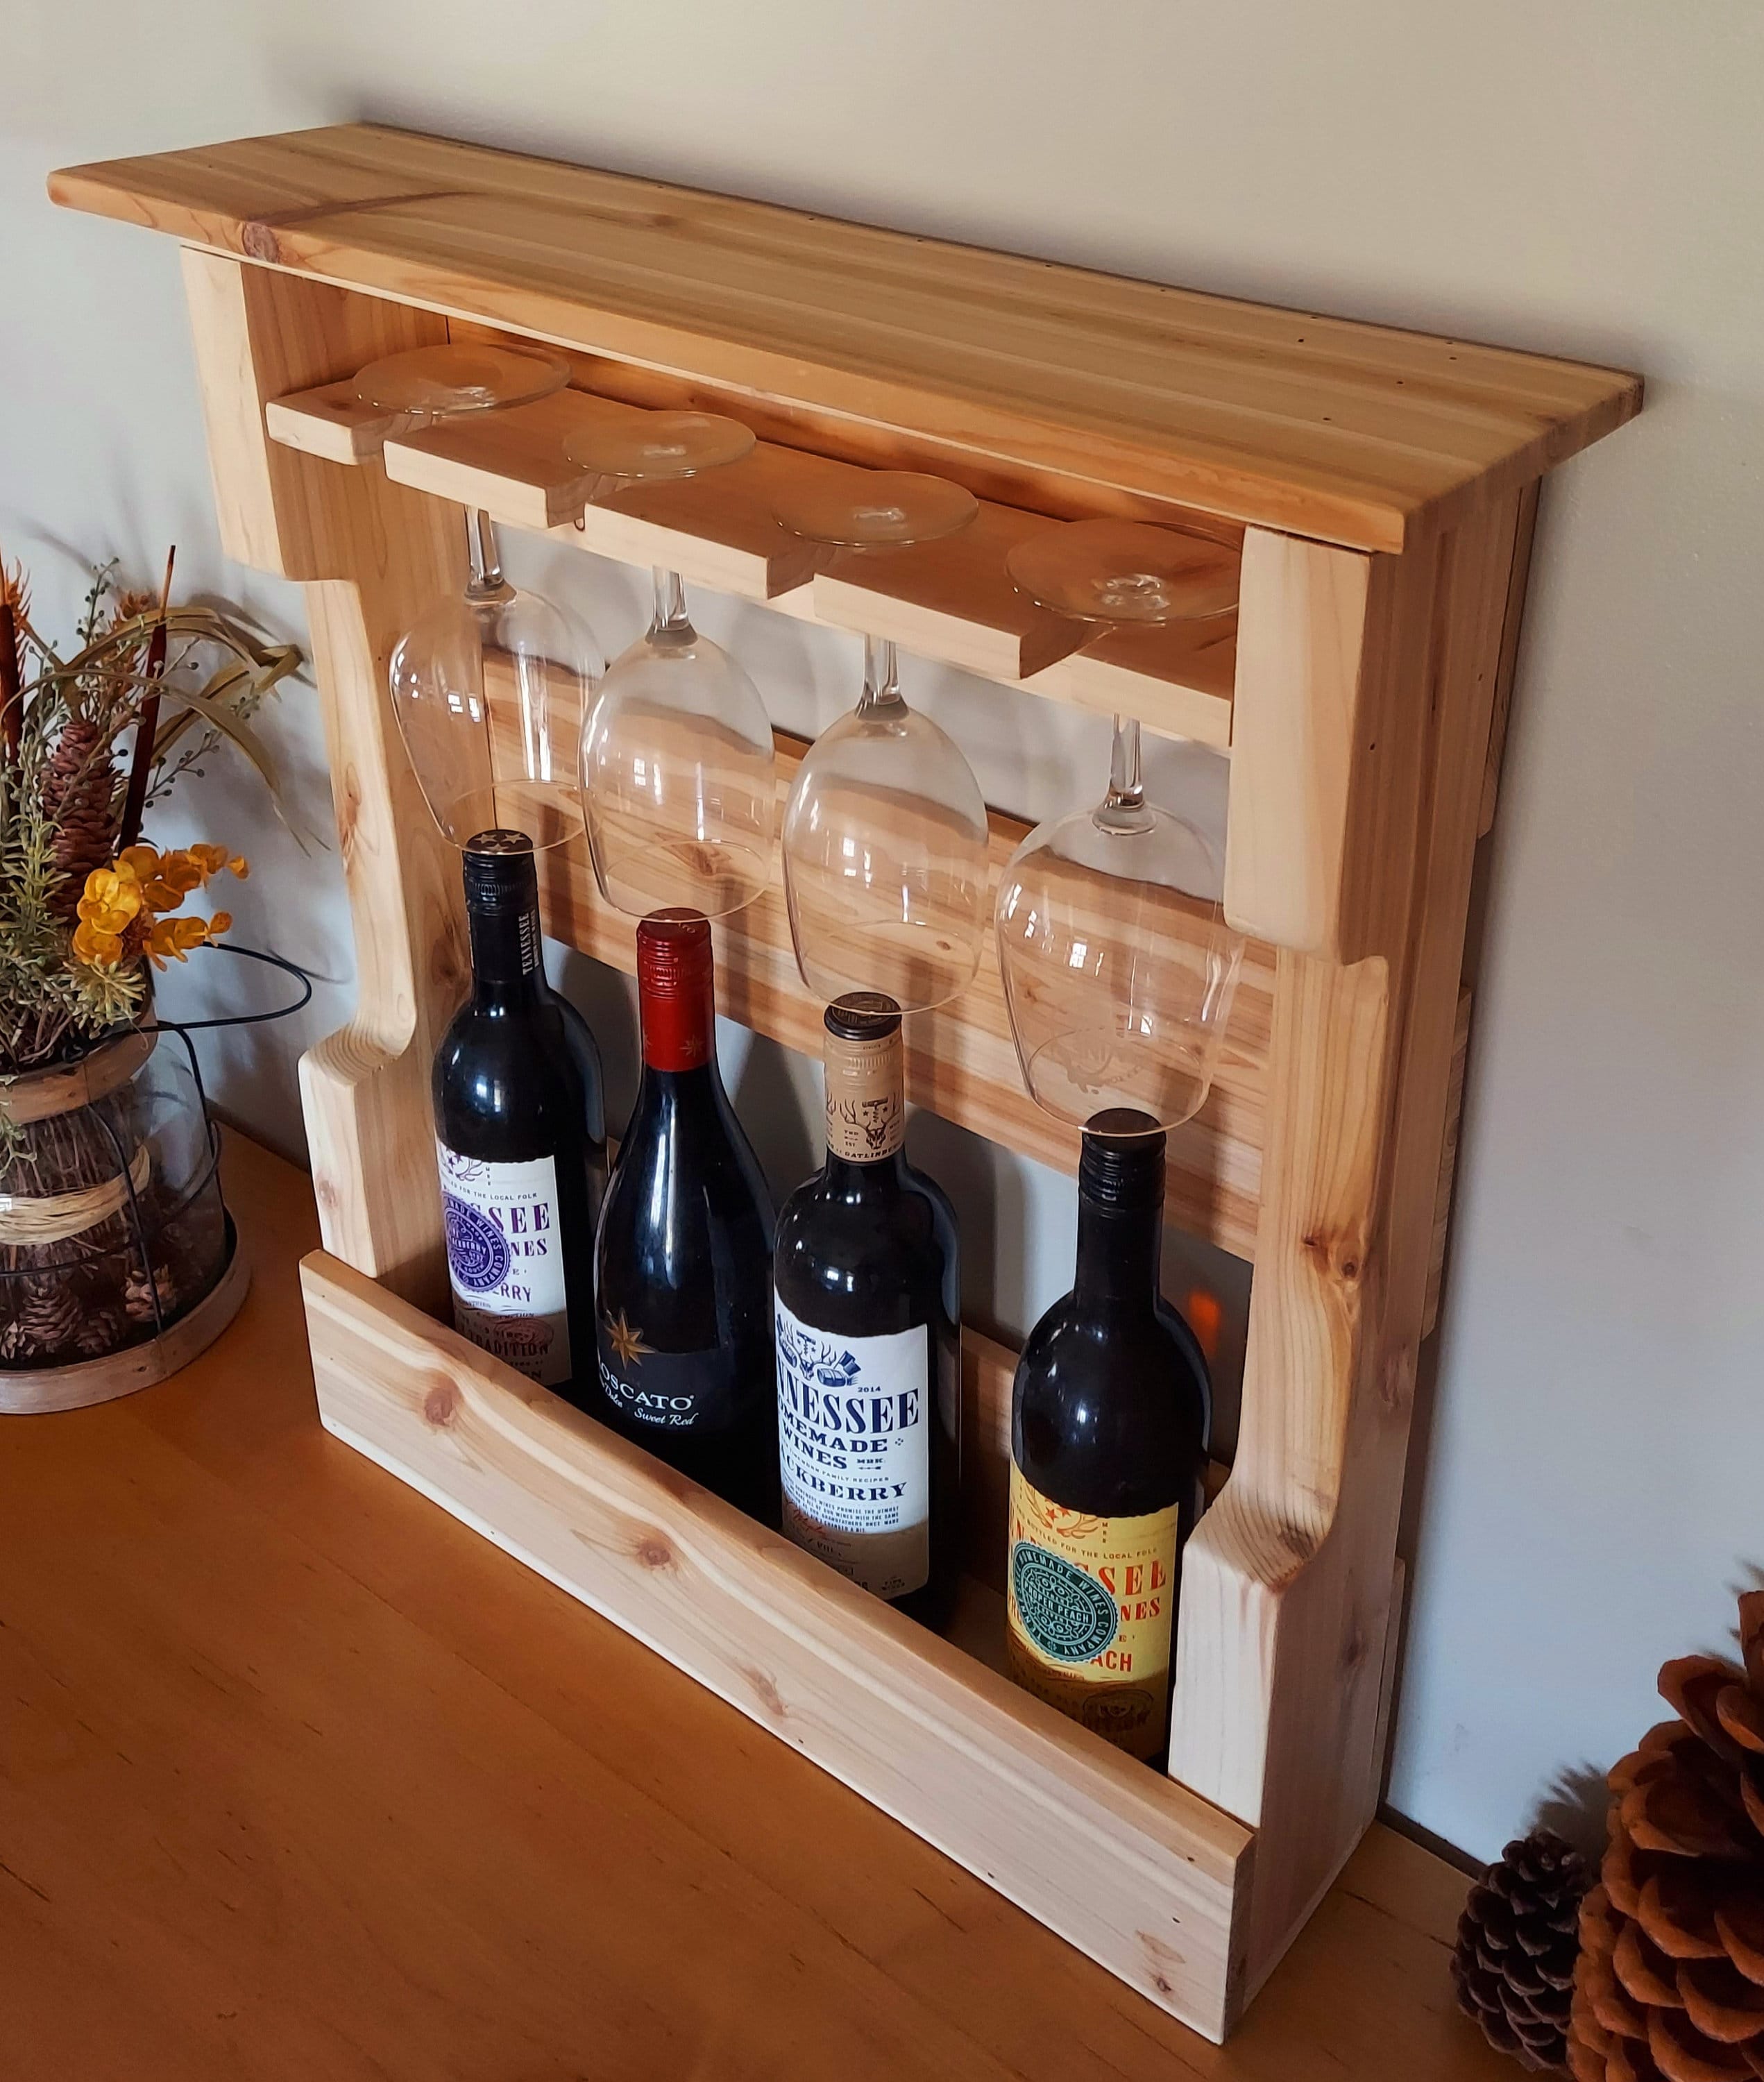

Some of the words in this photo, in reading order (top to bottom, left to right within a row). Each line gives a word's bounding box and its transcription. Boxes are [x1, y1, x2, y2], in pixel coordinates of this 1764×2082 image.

[476, 1219, 502, 1250] WINES
[473, 1255, 504, 1287] COMPANY
[493, 1282, 531, 1302] RRY
[634, 1407, 666, 1424] Sweet
[669, 1412, 699, 1425] Red
[783, 1419, 847, 1469] WINES
[822, 1471, 849, 1482] FAMILY
[1061, 1543, 1077, 1553] FOR
[1081, 1550, 1099, 1558] THE
[1024, 1582, 1053, 1610] PROPER
[1058, 1606, 1089, 1623] PEACH
[1078, 1580, 1109, 1616] WINES
[1064, 1621, 1110, 1656] COMPANY
